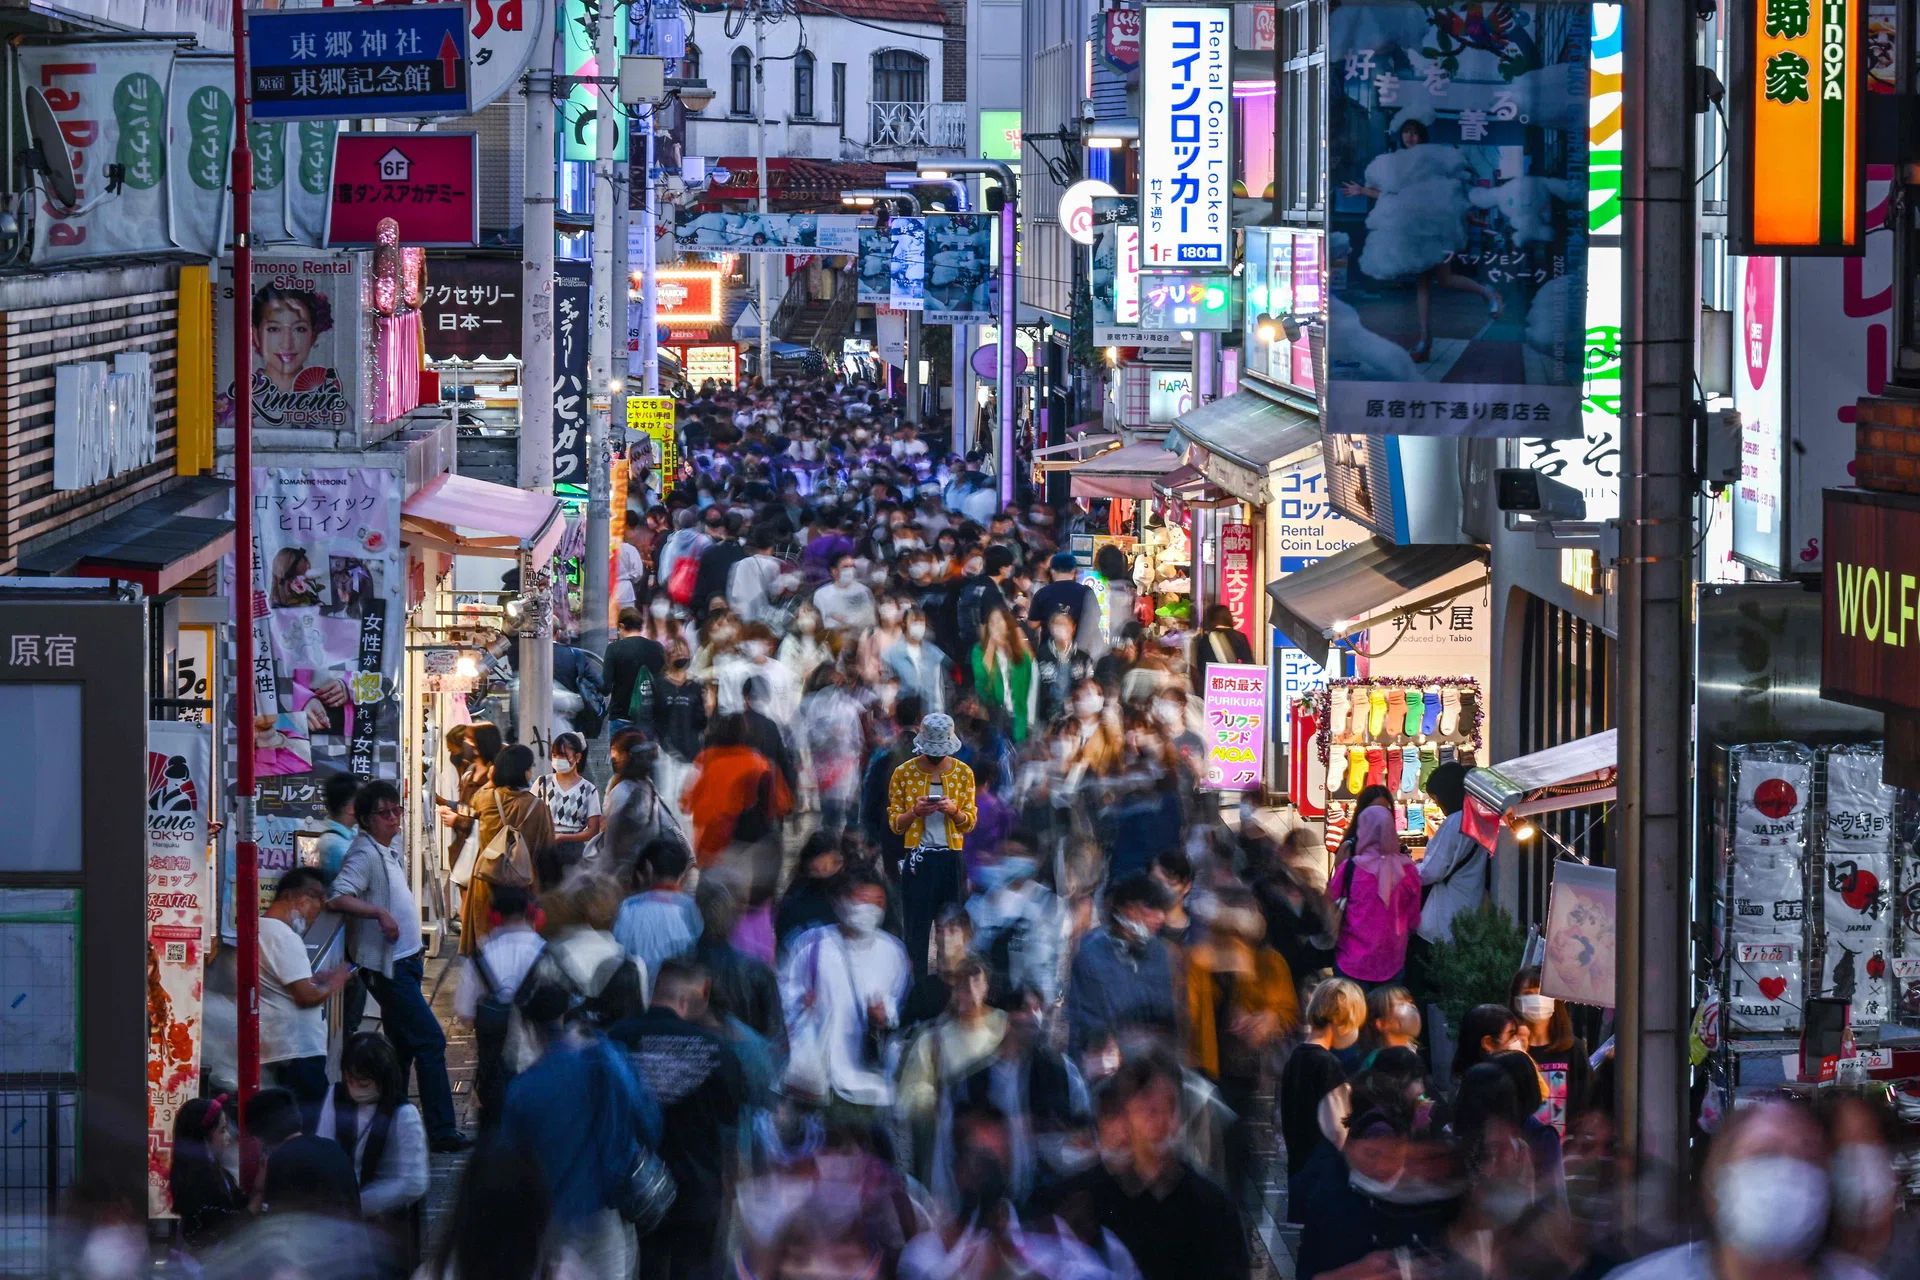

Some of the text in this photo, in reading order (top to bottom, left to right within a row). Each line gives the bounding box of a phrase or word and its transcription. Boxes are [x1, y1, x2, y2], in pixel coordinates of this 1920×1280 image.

[289, 28, 423, 60] 東郷神社
[258, 64, 431, 97] 原宿 東郷記念館
[1171, 21, 1200, 233] コインロッカー
[1208, 21, 1224, 234] Rental Coin Locker
[383, 161, 406, 176] 6F
[333, 184, 465, 204] 宿ダンスアカデミー
[1150, 178, 1163, 233] 竹下通り
[1149, 243, 1173, 262] 1F
[1181, 246, 1219, 259] 180個
[303, 260, 352, 274] Rental
[274, 275, 314, 292] Shop
[422, 285, 515, 306] アクセサリー
[1148, 284, 1226, 309] プリクラ
[438, 313, 503, 331] 日本一
[559, 297, 581, 368] ギャラリー
[1106, 333, 1170, 342] 原宿竹下通り商店会
[283, 411, 344, 423] TOKYO
[1366, 400, 1550, 422] 原宿竹下通り商店会
[553, 374, 586, 480] ハセガワ
[254, 495, 376, 511] ロマンティック
[1281, 499, 1342, 520] ロッカ
[279, 515, 352, 531] ヒロイン
[1281, 525, 1324, 536] Rental
[1281, 539, 1360, 551] Coin Locke
[1836, 562, 1920, 648] WOLF
[1436, 635, 1447, 644] by
[1449, 634, 1473, 642] Tabio
[9, 633, 77, 667] 原宿
[1212, 677, 1262, 692] 都内最大
[1286, 679, 1325, 691] ロッカ
[1208, 695, 1264, 707] PURIKURA
[1209, 710, 1261, 729] プリクラ
[1217, 731, 1251, 744] ランド
[1208, 745, 1257, 762] NOA
[1232, 771, 1255, 782] ノア
[1752, 820, 1795, 836] JAPAN
[152, 841, 180, 849] Harajuku
[1739, 904, 1764, 916] TOKYO
[1845, 924, 1873, 932] JAPAN
[1732, 979, 1744, 998] I
[1736, 1005, 1781, 1016] JAPAN
